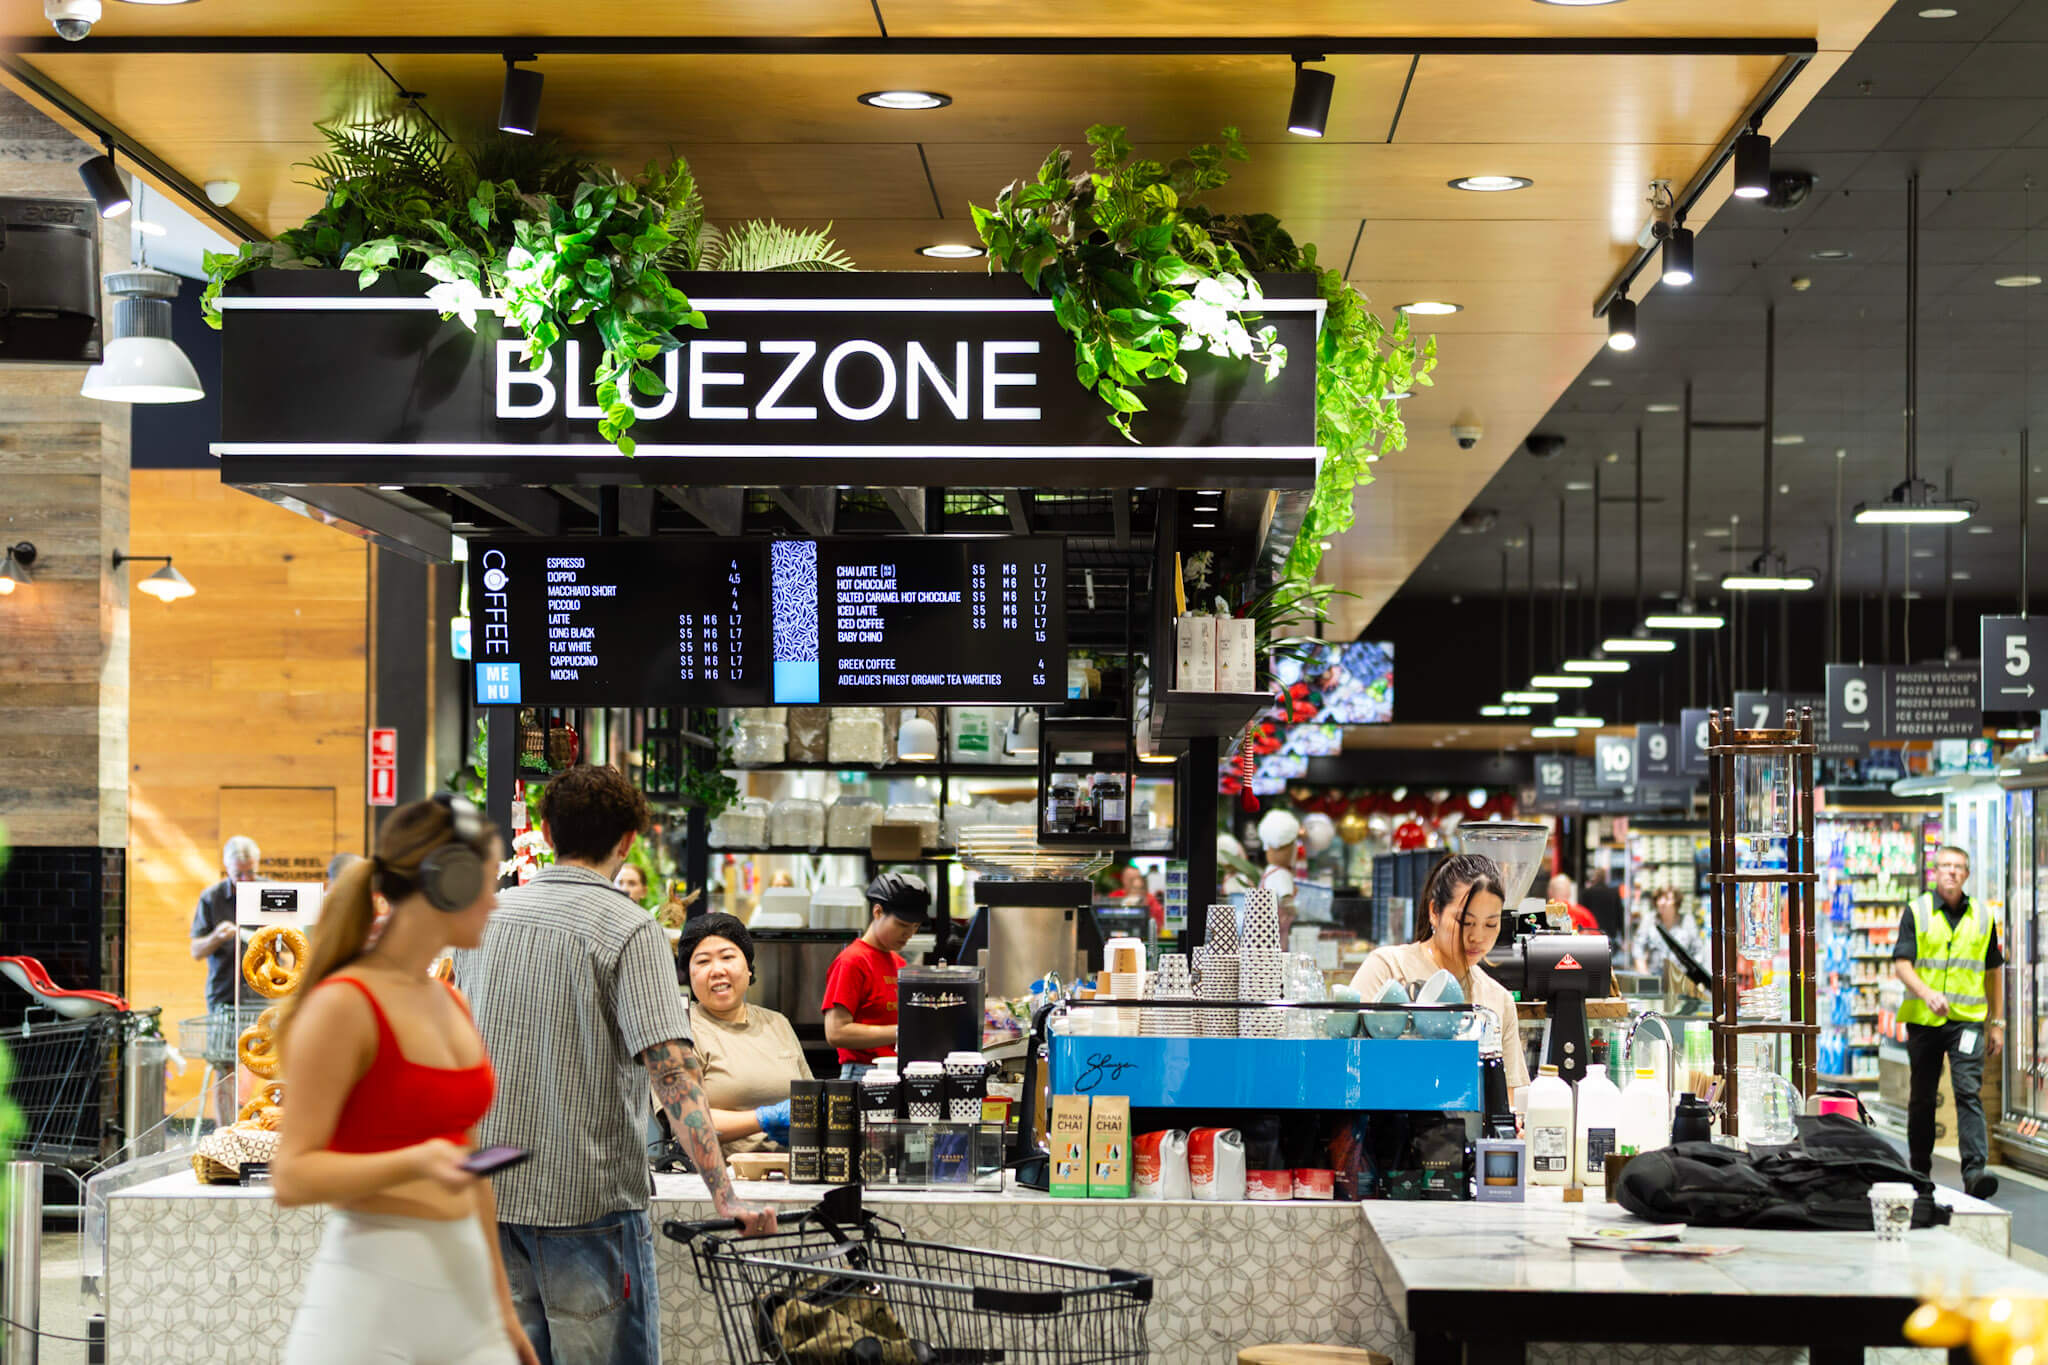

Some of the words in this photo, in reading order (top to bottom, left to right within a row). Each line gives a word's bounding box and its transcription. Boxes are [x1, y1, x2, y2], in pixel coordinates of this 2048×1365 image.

[496, 339, 1041, 421] BLUEZONE
[547, 558, 584, 568] ESPRESSO
[732, 560, 737, 570] 4
[548, 572, 576, 582] DOPPIO
[837, 566, 855, 577] CHAI
[857, 566, 877, 576] LATTE
[837, 579, 852, 590] HOT
[854, 579, 897, 590] CHOCOLATE
[548, 586, 590, 596] MACCHIATO
[592, 586, 616, 596] SHORT
[732, 588, 738, 598] 4
[837, 592, 864, 603] SALTED
[865, 592, 899, 603] CARAMEL
[901, 592, 916, 602] HOT
[918, 592, 961, 602] CHOCOLATE
[483, 550, 509, 655] COFFEE
[549, 600, 580, 610] PICCOLO
[732, 601, 739, 611] 4
[837, 605, 855, 616] ICED
[857, 605, 877, 616] LATTE
[549, 614, 570, 624] LATTE
[838, 618, 855, 629] ICED
[857, 618, 884, 629] COFFEE
[549, 628, 569, 638] LONG
[571, 627, 594, 638] BLACK
[838, 632, 858, 642] BABY
[859, 632, 882, 642] CHINO
[550, 642, 566, 652] FLAT
[568, 642, 591, 652] WHITE
[550, 656, 598, 666] CAPPUCCINO
[2005, 635, 2030, 676] 5
[838, 659, 864, 669] GREEK
[866, 659, 895, 669] COFFEE
[1038, 659, 1045, 670] 4
[486, 667, 509, 681] ME
[551, 669, 578, 680] MOCHA
[883, 675, 910, 685] FINEST
[912, 675, 945, 685] ORGANIC
[947, 674, 961, 685] TEA
[962, 674, 1001, 685] VARIETIES
[1896, 672, 1929, 682] FROZEN
[487, 685, 509, 700] NU
[1896, 685, 1933, 695] FROZEN
[1936, 685, 1969, 695] MEALS
[1844, 679, 1868, 714] 6
[1896, 698, 1929, 708] FROZEN
[1931, 698, 1976, 708] DESSERTS
[1752, 705, 1769, 729] 7
[1896, 711, 1912, 720] ICE
[1915, 711, 1949, 720] CREAM
[1896, 724, 1933, 734] FROZEN
[1936, 724, 1973, 734] PASTRY
[1648, 734, 1667, 760] 9
[1601, 744, 1630, 771] 10
[1541, 763, 1563, 785] 12
[1057, 1121, 1083, 1130] CHAI
[1096, 1121, 1122, 1130] CHAI
